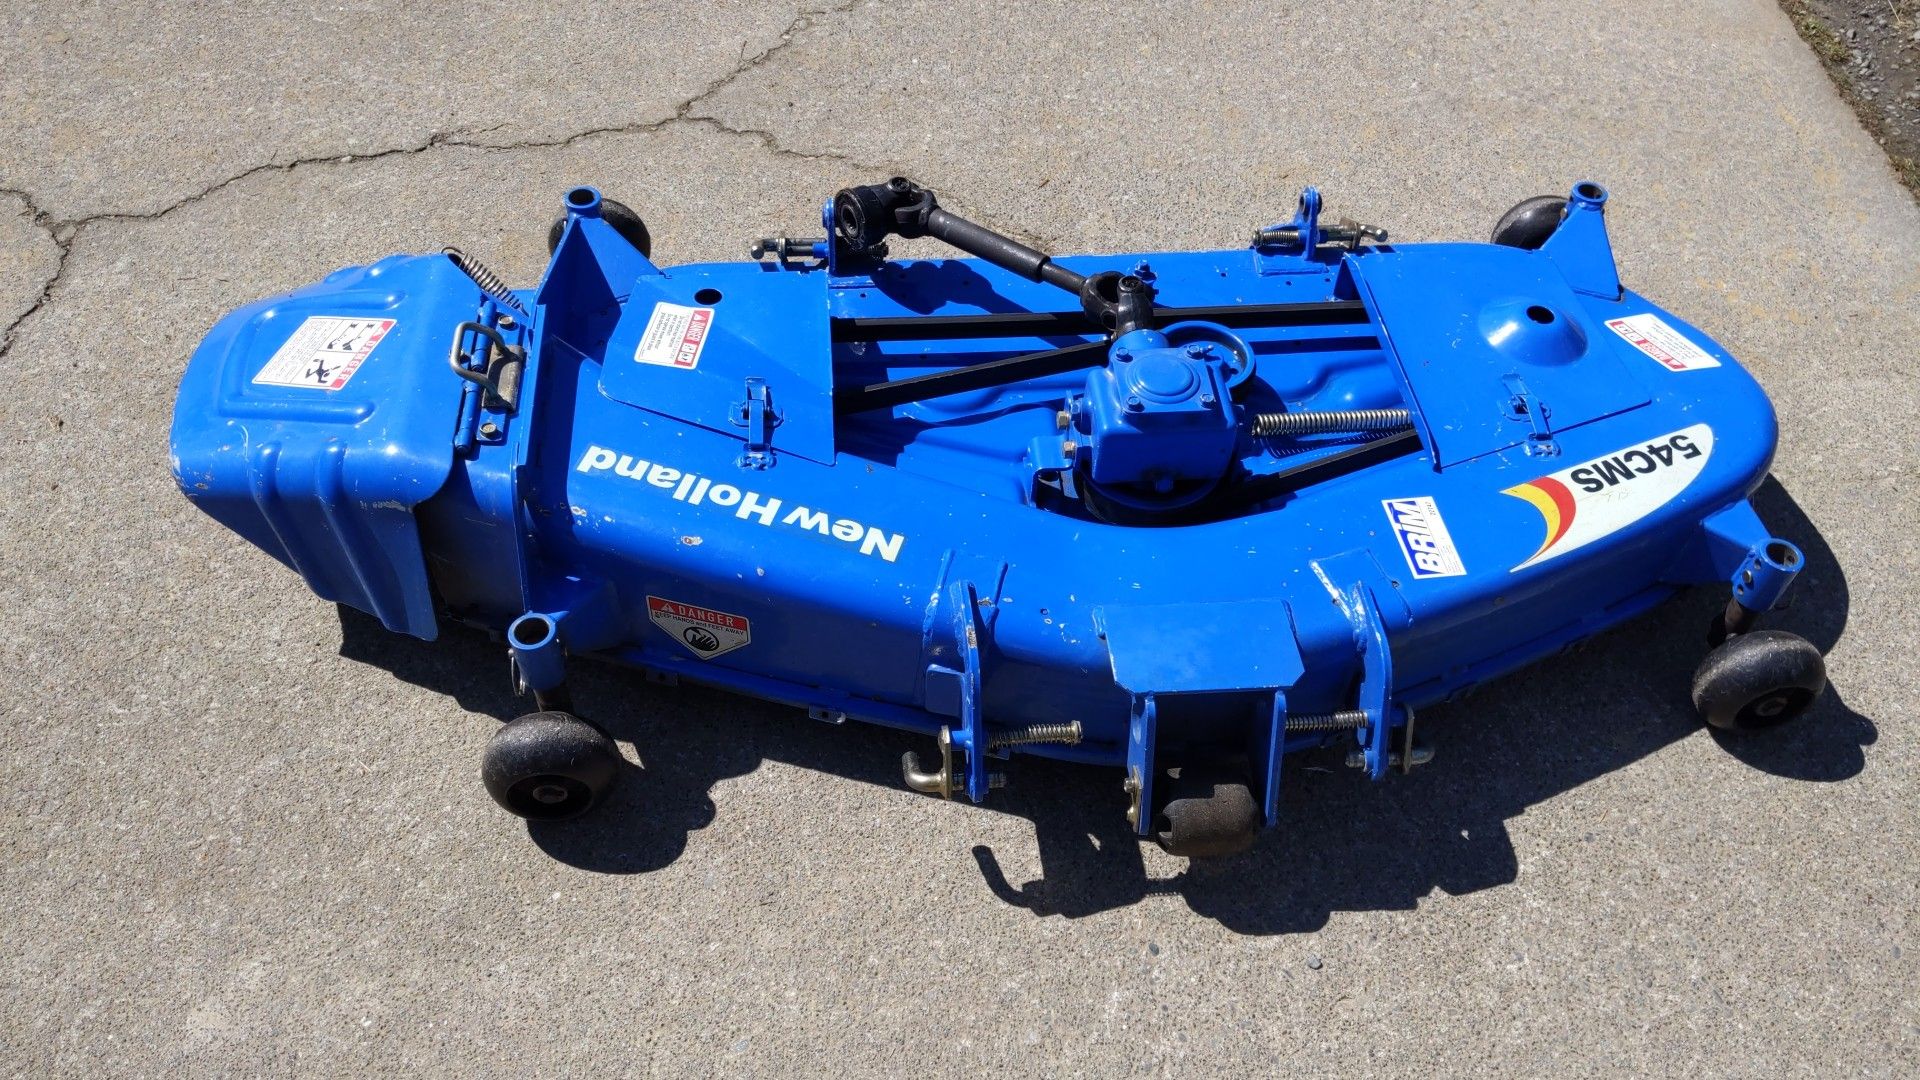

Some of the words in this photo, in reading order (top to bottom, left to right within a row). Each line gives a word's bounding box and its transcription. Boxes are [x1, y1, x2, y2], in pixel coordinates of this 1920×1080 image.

[337, 339, 377, 380] DANGER
[576, 444, 783, 527] Holland
[1570, 435, 1702, 493] 54CMS
[782, 505, 905, 563] New
[1390, 502, 1447, 575] BRIM
[673, 615, 695, 625] HANDS
[708, 623, 724, 632] FEET
[725, 628, 745, 636] AWAY
[678, 605, 734, 627] DANGER
